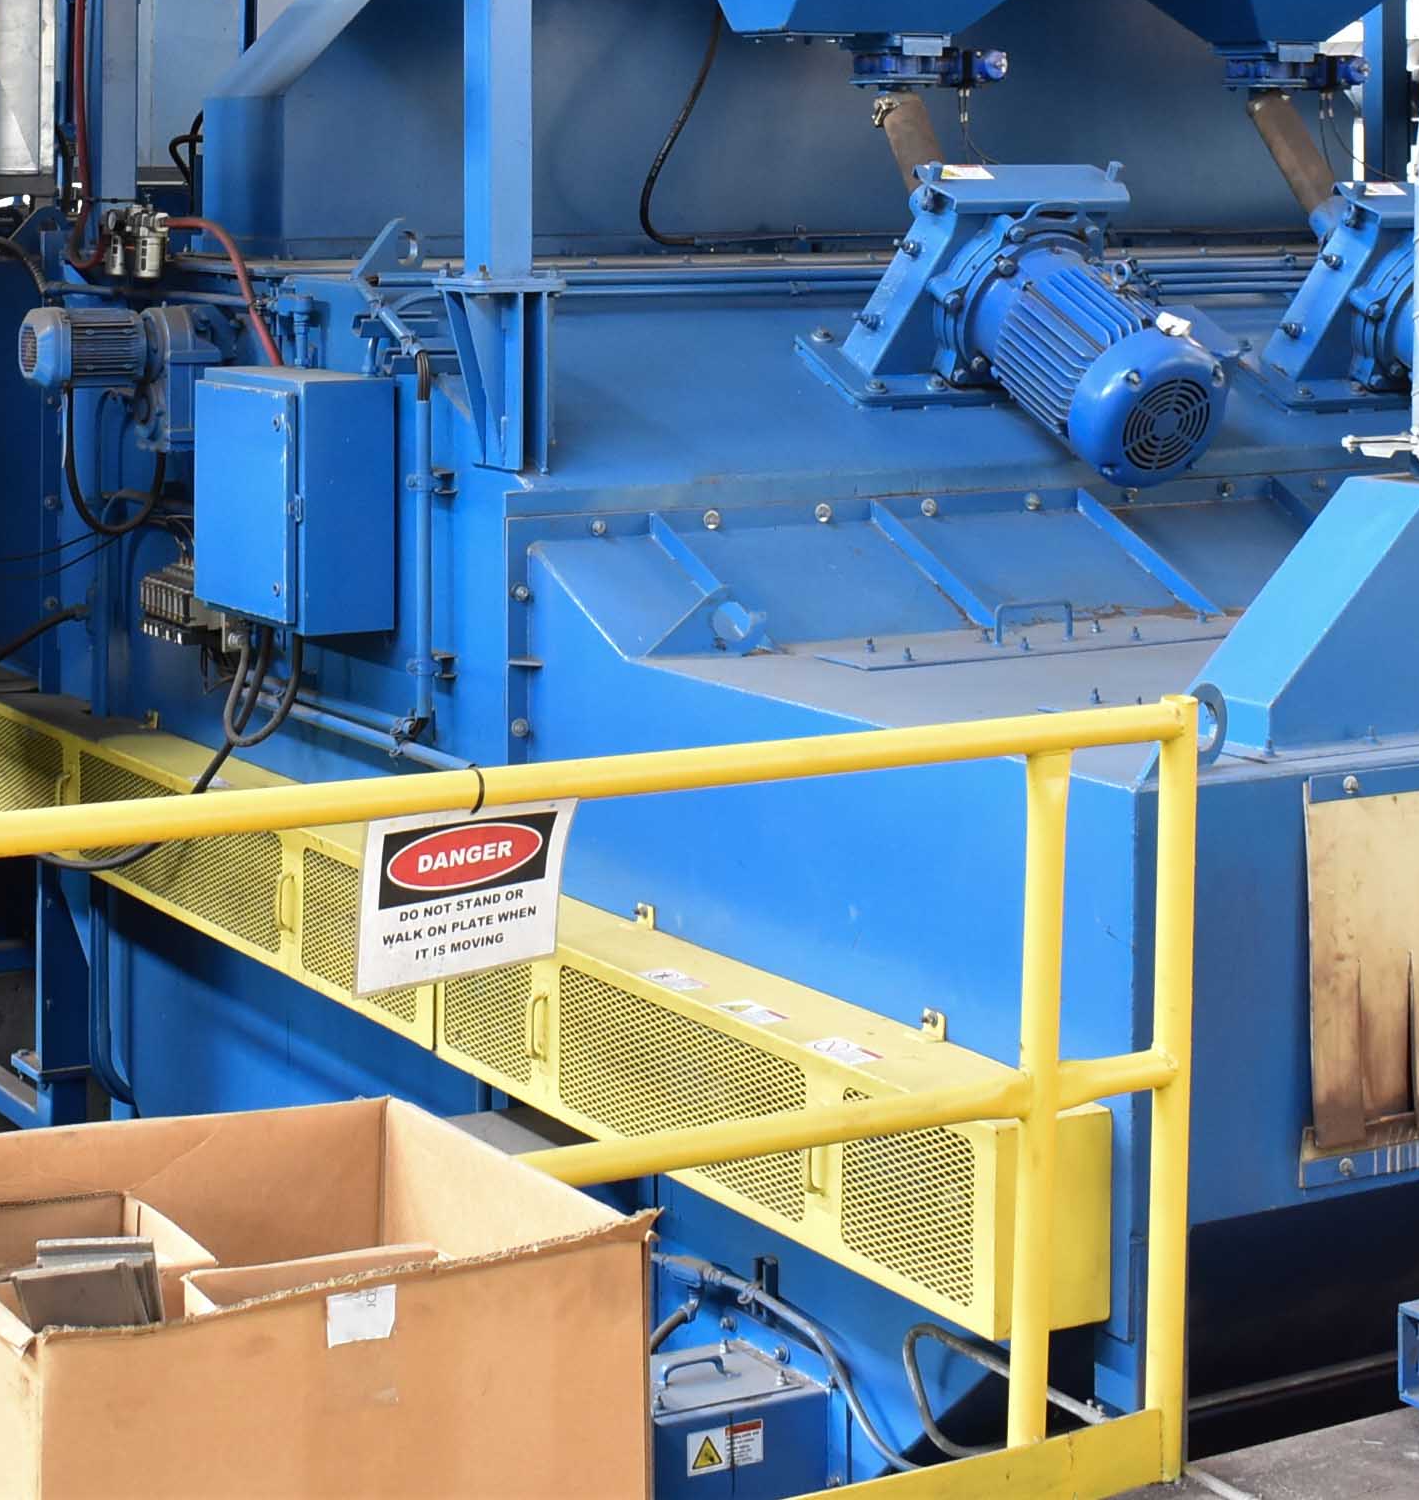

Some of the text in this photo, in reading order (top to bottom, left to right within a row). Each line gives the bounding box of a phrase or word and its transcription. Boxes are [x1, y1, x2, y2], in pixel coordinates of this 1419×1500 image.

[418, 840, 512, 873] DANGER
[399, 888, 524, 922] DO NOT STAND OR
[382, 906, 537, 945] WALK ON PLATE WHEN
[415, 932, 505, 960] IT IS MOVING
